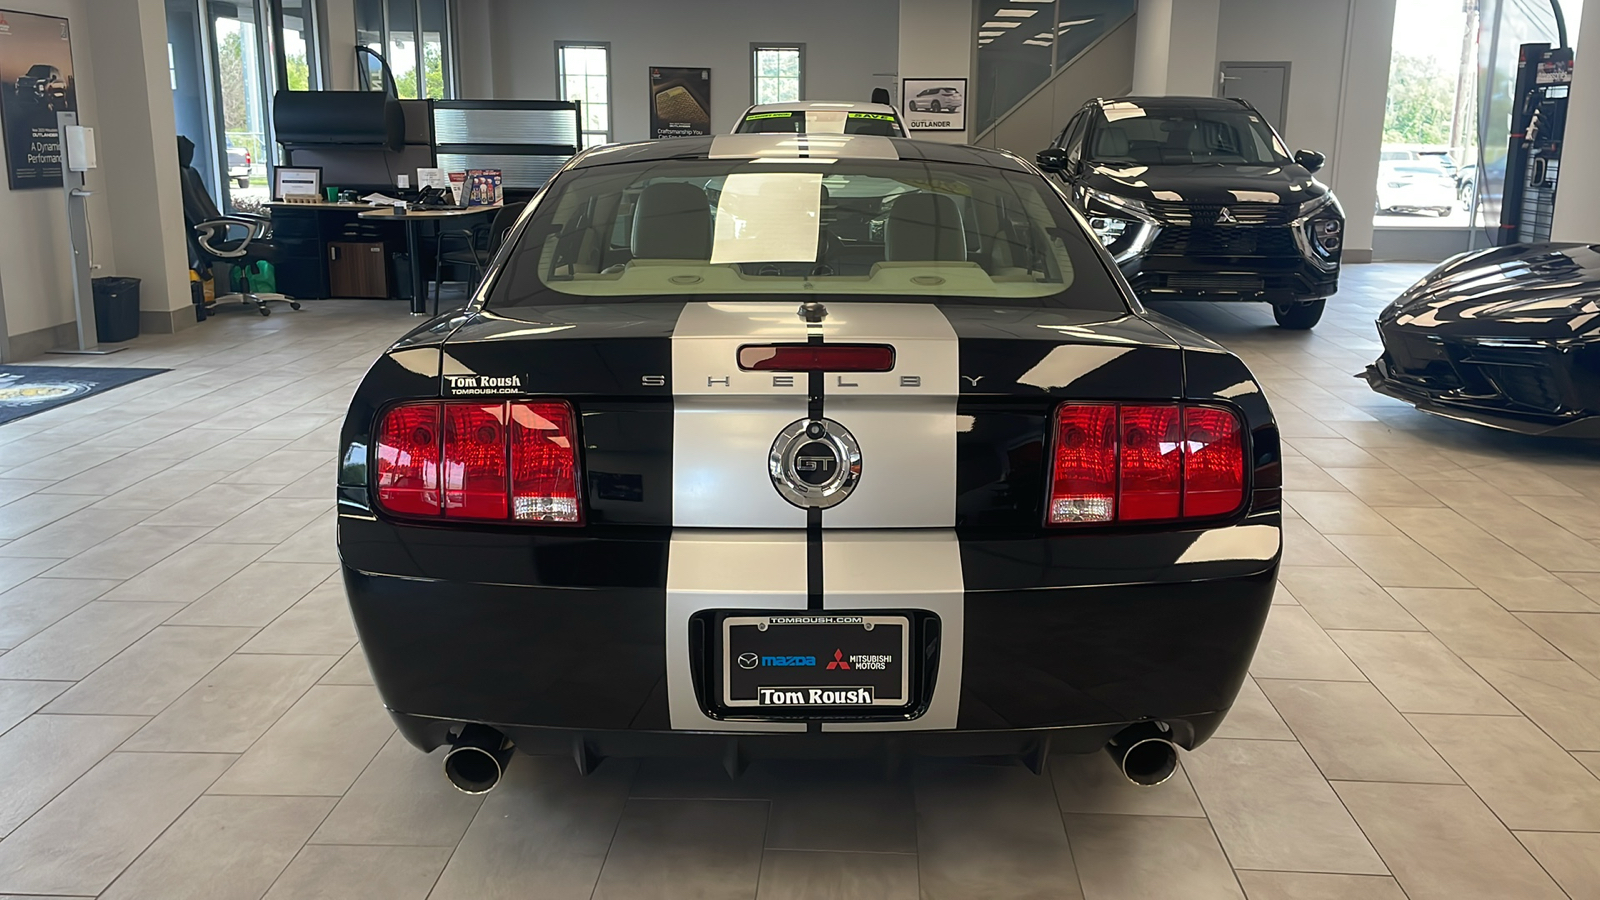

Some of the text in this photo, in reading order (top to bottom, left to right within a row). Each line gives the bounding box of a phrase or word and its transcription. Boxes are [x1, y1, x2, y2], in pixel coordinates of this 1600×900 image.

[31, 142, 36, 151] A
[27, 153, 62, 164] Performanc
[449, 375, 521, 387] Tom Roush
[642, 375, 986, 387] SHELBY
[797, 456, 835, 471] GT
[849, 655, 892, 663] MITSUBISHI
[855, 662, 886, 670] MOTORS
[760, 688, 871, 705] Tom Roush
